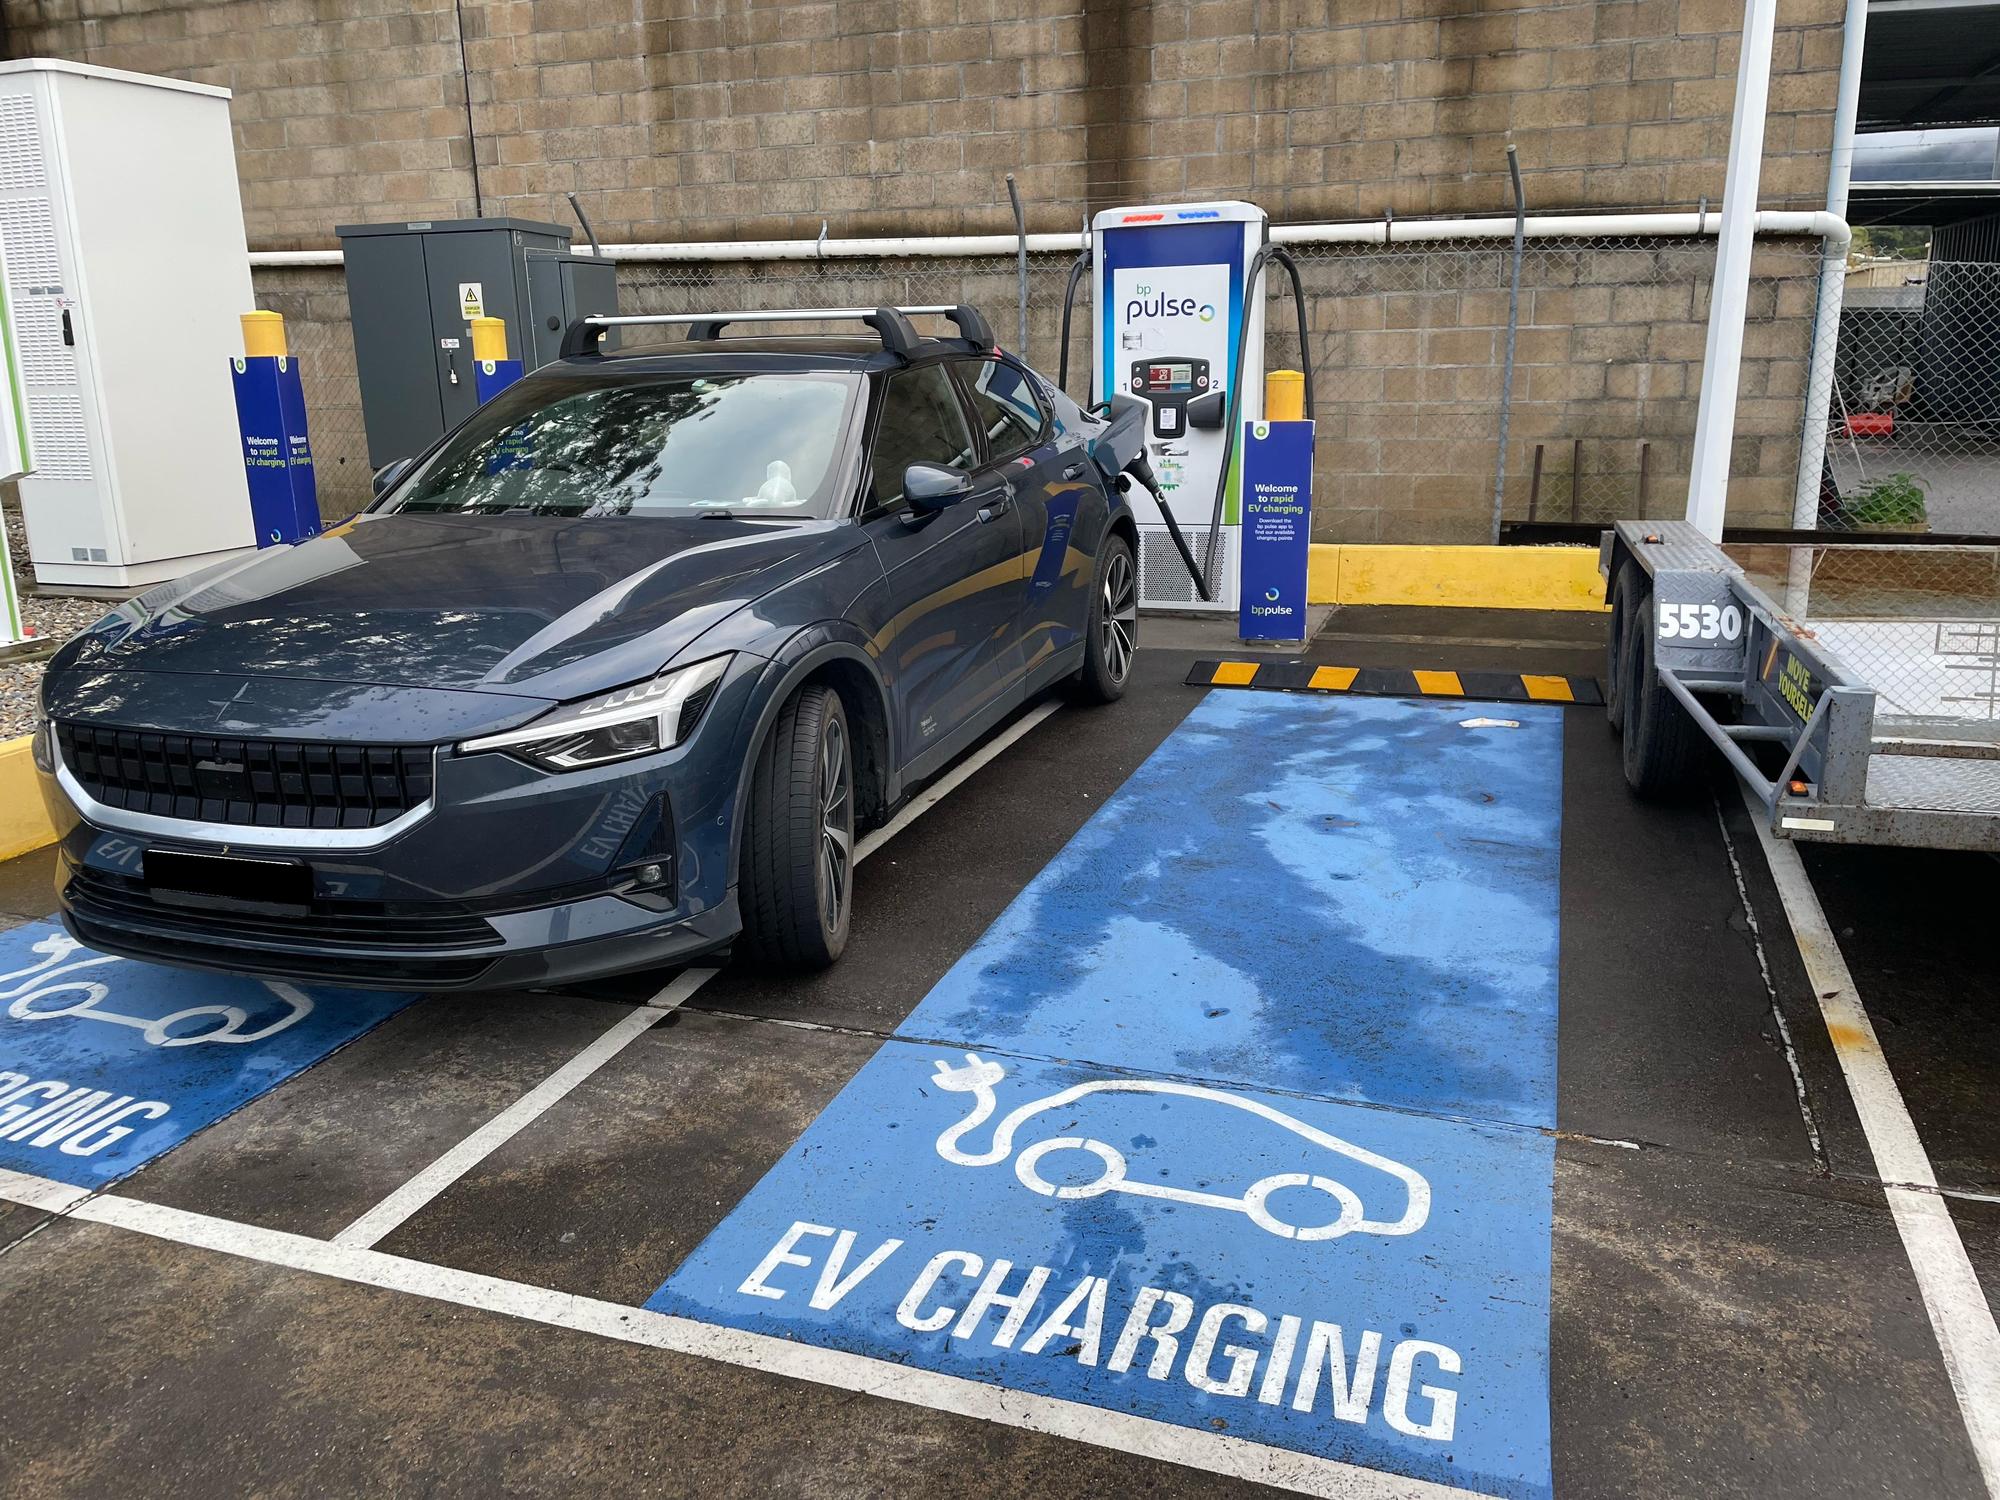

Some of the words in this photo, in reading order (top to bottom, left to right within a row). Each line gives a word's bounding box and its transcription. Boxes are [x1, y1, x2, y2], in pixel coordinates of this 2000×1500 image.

[1136, 284, 1151, 296] bp
[1127, 292, 1196, 325] pulse
[1123, 383, 1127, 391] 1
[1212, 380, 1219, 389] 2
[246, 436, 278, 445] Welcome
[289, 436, 306, 444] Welcome
[260, 447, 277, 457] rapid
[246, 457, 255, 466] EV
[257, 458, 285, 468] charging
[1255, 484, 1298, 492] Welcome
[1270, 494, 1294, 504] rapid
[1248, 504, 1261, 512] EV
[1263, 504, 1303, 515] charging
[1658, 603, 1742, 641] 5530
[1787, 653, 1811, 693] MOVE
[1778, 669, 1814, 725] YOURSELF
[736, 1220, 904, 1311] EV
[896, 1250, 1461, 1442] CHARGING
